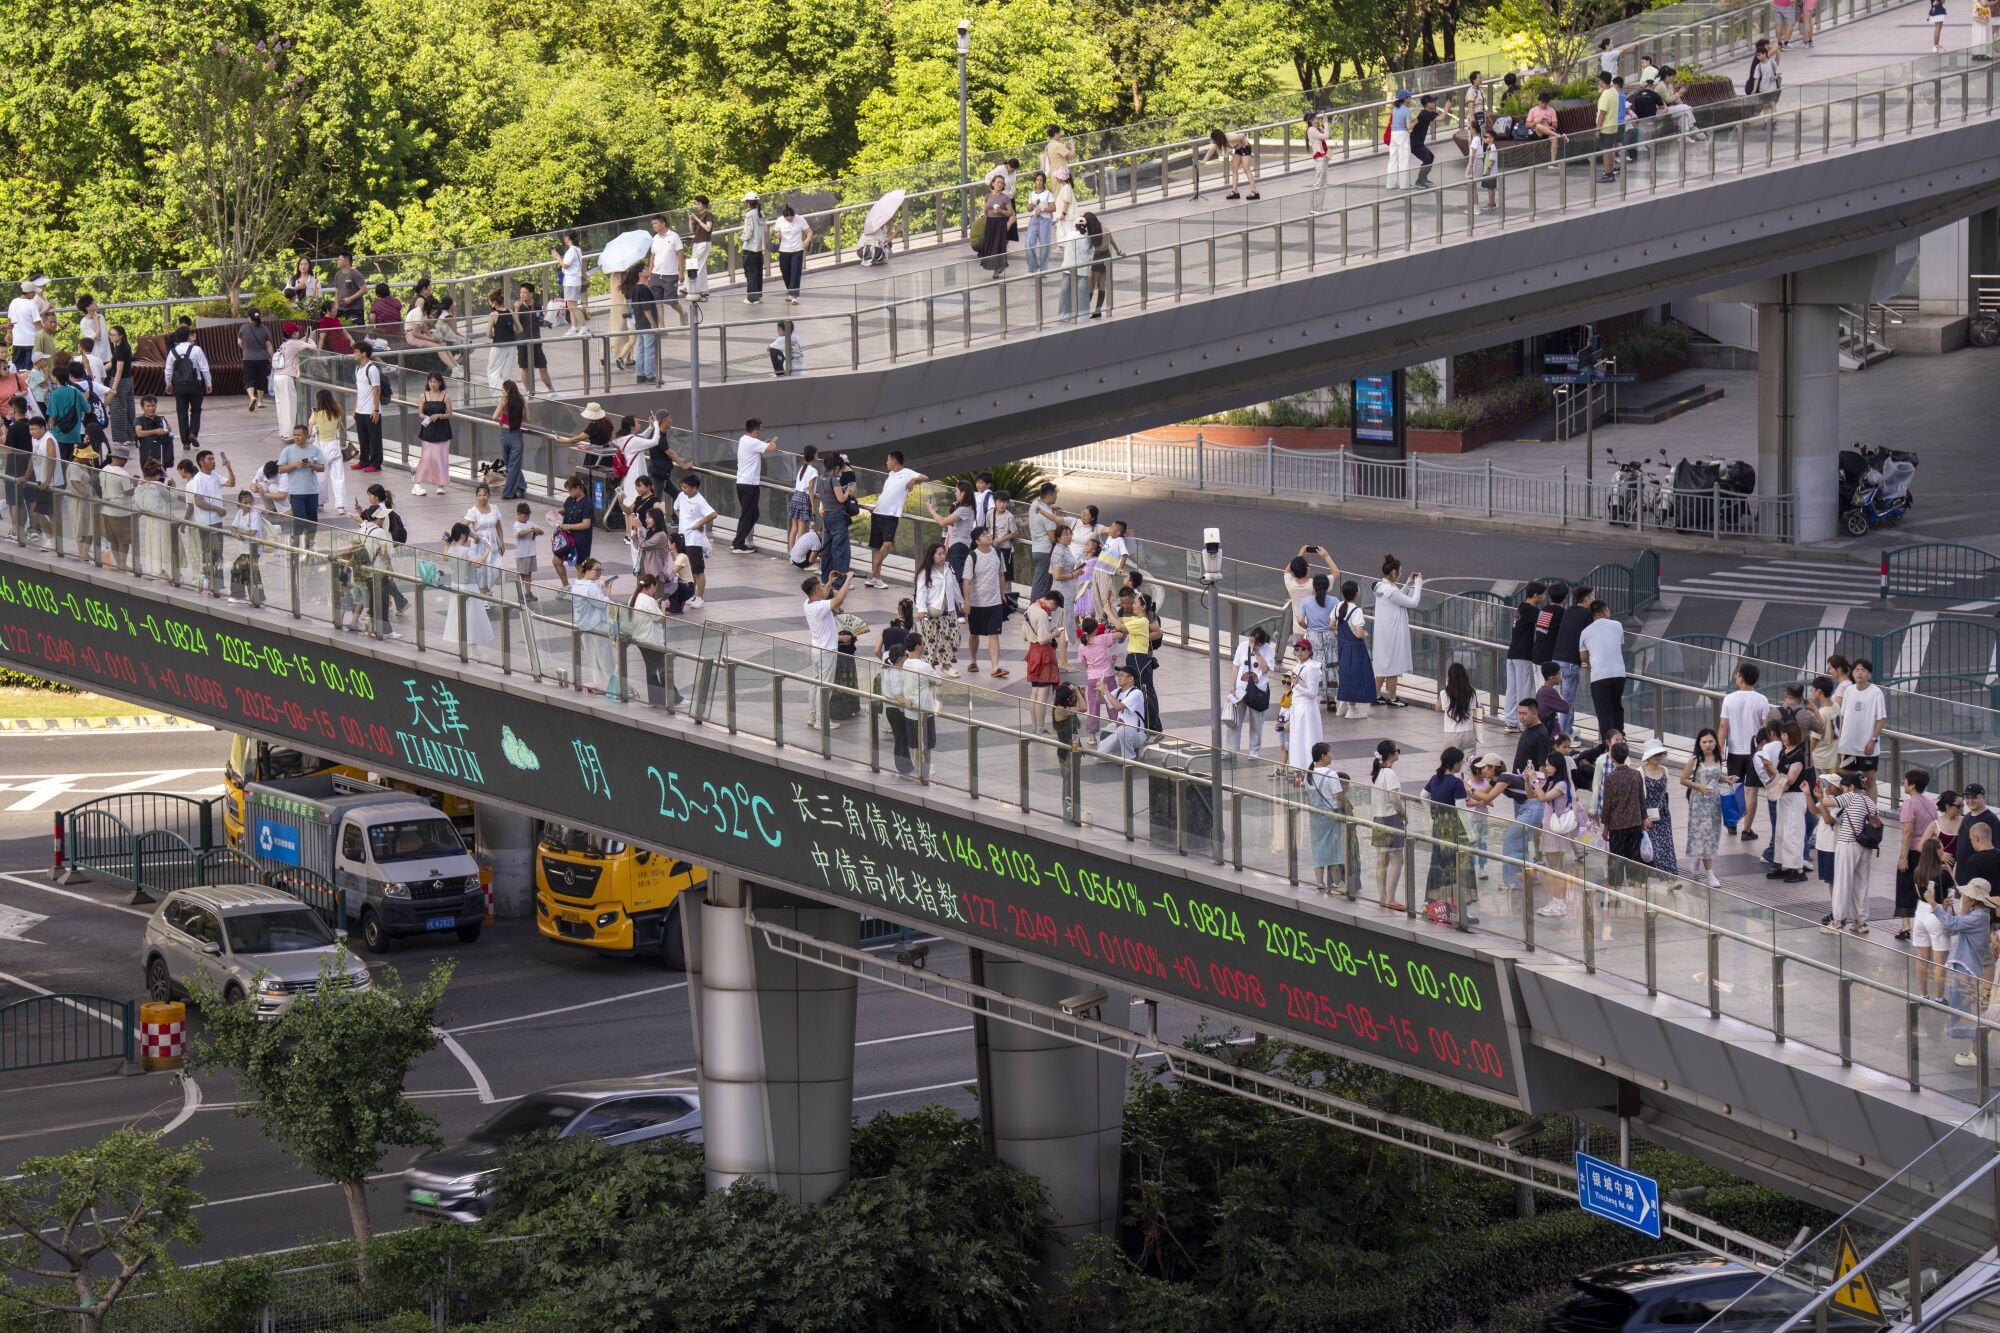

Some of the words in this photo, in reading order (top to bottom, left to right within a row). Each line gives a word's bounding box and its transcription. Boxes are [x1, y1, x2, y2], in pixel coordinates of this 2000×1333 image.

[3, 623, 77, 663] 127.2049
[160, 667, 229, 711] +0.0098
[235, 687, 336, 740] 2025-08-15
[339, 714, 395, 757] 00:00
[140, 614, 209, 656] -0.0824
[216, 632, 316, 685] 2025-08-15
[320, 661, 375, 700] 00:00
[403, 679, 470, 745] 天津
[396, 731, 485, 785] TIANJIN
[791, 782, 947, 862] 长三角债指数
[1152, 892, 1246, 945] -0.0824
[1258, 919, 1398, 988] 2025-08-15
[1407, 960, 1482, 1012] 00:00
[810, 841, 968, 924] 中债高收指数
[1173, 955, 1267, 1009] +0.0098
[1279, 983, 1420, 1053] 2025-08-15
[1428, 1026, 1503, 1079] 00:00
[1592, 1170, 1634, 1200] 银城中路
